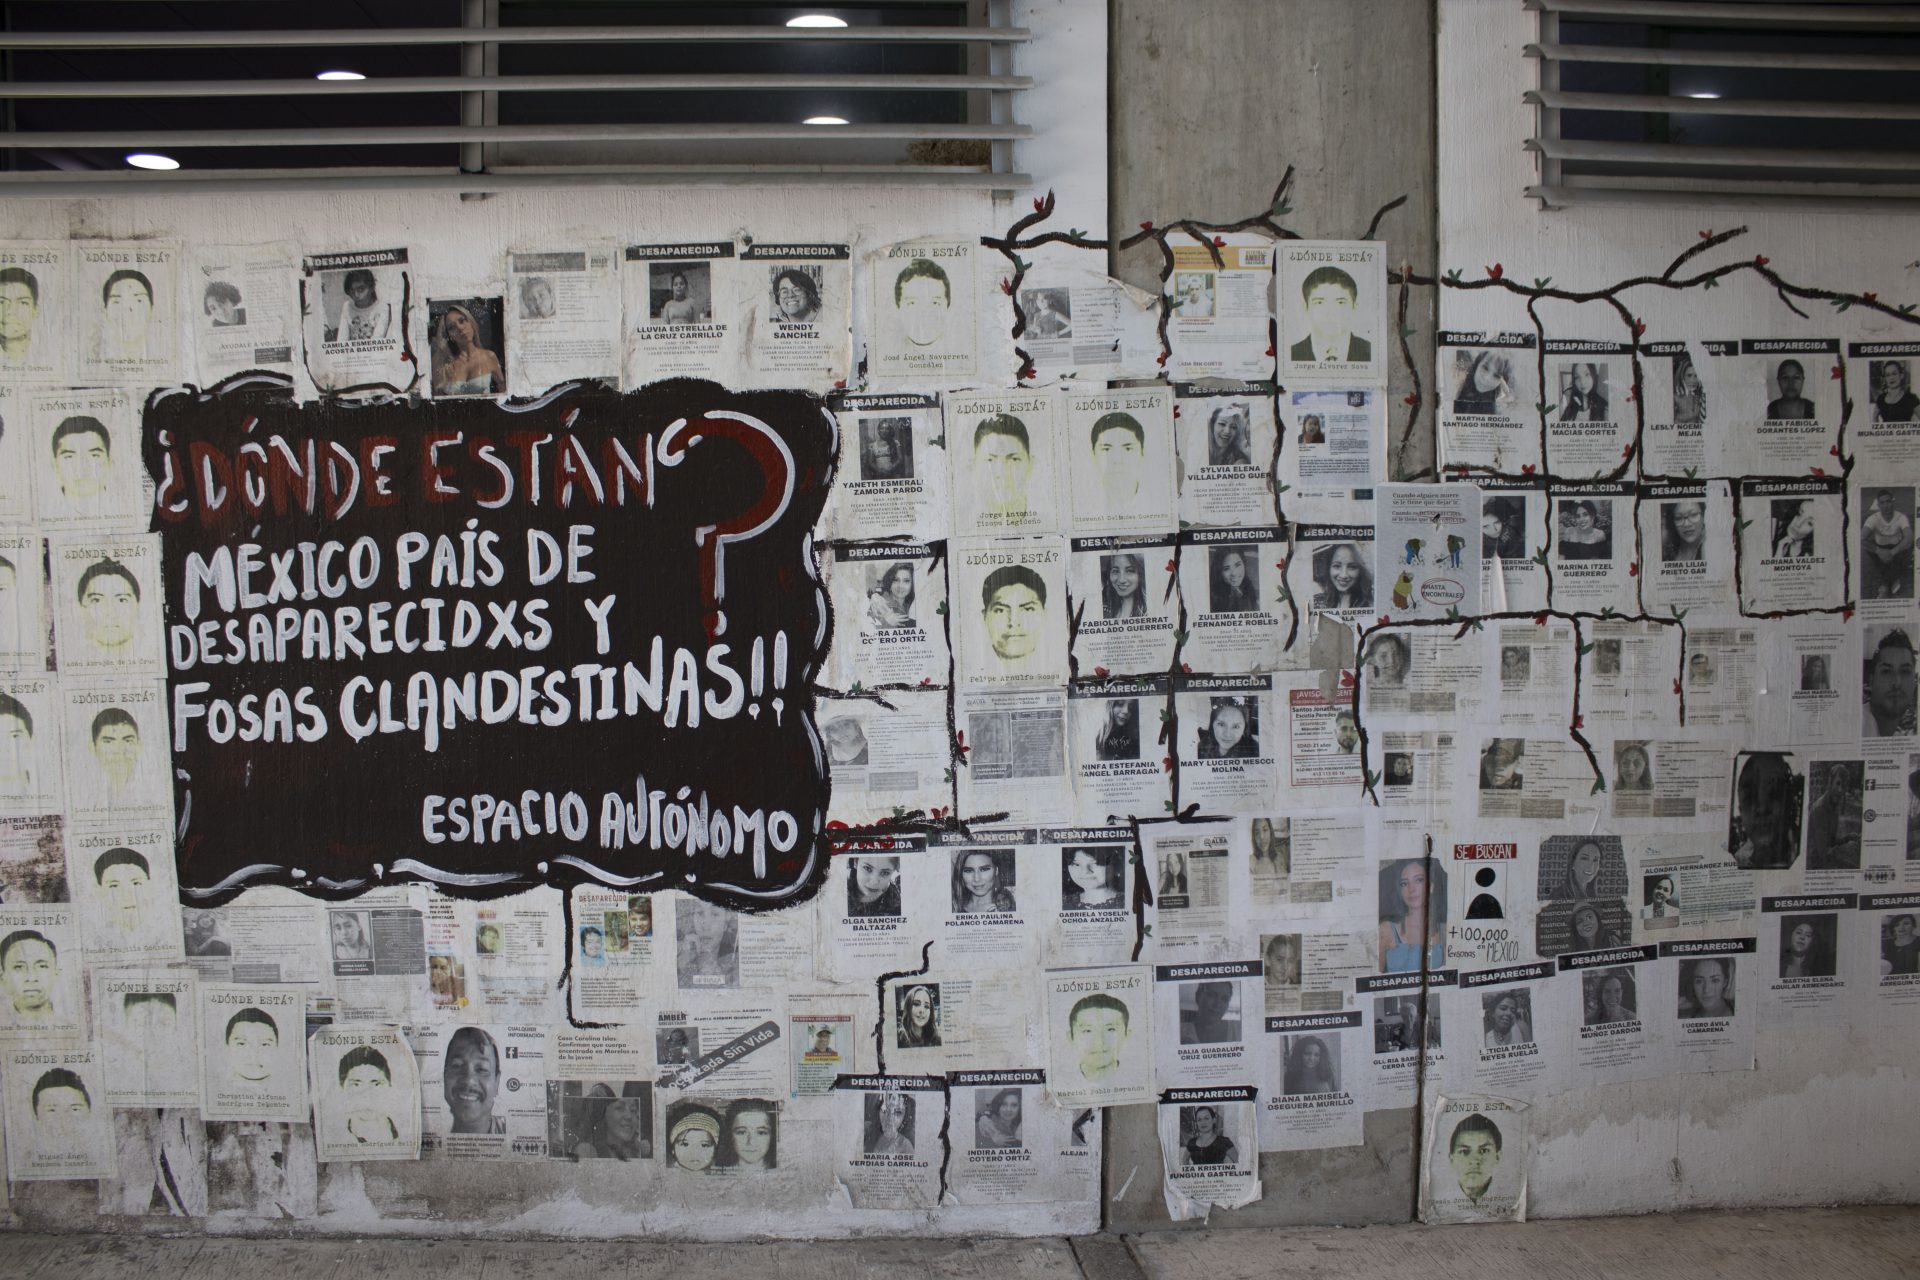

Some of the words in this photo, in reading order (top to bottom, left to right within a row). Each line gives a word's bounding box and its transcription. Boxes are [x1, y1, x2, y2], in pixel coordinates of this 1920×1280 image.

[639, 246, 721, 257] DESAPARECIDA
[754, 247, 836, 256] DESAPARECIDA
[932, 246, 968, 258] ESTÁ?
[1290, 250, 1332, 262] ¿DÓNDE
[1339, 251, 1373, 262] ESTÁ?
[135, 251, 171, 264] ESTÁ?
[315, 252, 394, 267] DESAPARECIDA
[680, 331, 723, 339] CARRILLO
[774, 331, 820, 340] SANCHEZ
[1545, 342, 1621, 351] DESAPARECIDA
[1753, 342, 1828, 351] DESAPARECIDA
[843, 396, 926, 408] DESAPARECIDA
[956, 403, 1002, 415] ¿DÓNDE
[1009, 400, 1046, 412] ESTÁ?
[1075, 400, 1119, 411] ¿DÓNDE
[1126, 397, 1161, 409] ESTÁ?
[843, 480, 878, 489] YANETH
[1755, 483, 1828, 492] DESAPARECIDA
[854, 488, 890, 496] ZAMORA
[893, 486, 923, 494] PARDO
[1193, 531, 1273, 541] DESAPARECIDA
[64, 547, 108, 559] ¿DÓNDE
[113, 546, 147, 557] ESTÁ?
[966, 553, 1013, 565] ¿DÓNDE
[1021, 551, 1059, 563] ESTÁ?
[184, 525, 380, 624] MÉXICO
[396, 517, 504, 590] PAÍS
[527, 525, 596, 585] DE
[1121, 617, 1169, 625] MOSERRAT
[1192, 620, 1243, 628] FERNANDEZ
[1245, 618, 1279, 626] ROBLES
[171, 598, 553, 670] DESAPARECIDXS
[584, 594, 616, 655] Y
[892, 629, 916, 637] ALMA
[1078, 626, 1125, 634] REGALADO
[1128, 623, 1174, 632] GUERRERO
[899, 635, 926, 643] ORTIZ
[1188, 678, 1267, 688] DESAPARECIDA
[174, 681, 328, 752] FOSAS
[339, 630, 788, 752] CLANDESTINAS!!
[72, 692, 117, 704] ¿DÓNDE
[121, 690, 155, 703] ESTÁ?
[1082, 763, 1107, 771] NINFA
[1108, 761, 1154, 769] ESTEFANIA
[1180, 760, 1204, 768] MARY
[1207, 759, 1240, 767] LUCERO
[1212, 765, 1245, 773] MOLINA
[1113, 767, 1159, 776] BARRAGAN
[422, 789, 589, 843] ESPACIO
[600, 773, 798, 880] AUTÓNOMO
[1053, 829, 1134, 840] DESAPARECIDA
[79, 836, 122, 848] ¿DÓNDE
[128, 833, 162, 845] ESTÁ?
[1456, 845, 1470, 858] SE
[1475, 845, 1511, 858] BUSCAN
[1645, 866, 1678, 874] ALONDRA
[1774, 897, 1846, 908] DESAPARECIDA
[34, 913, 68, 926] ESTÁ?
[867, 916, 908, 924] SANCHEZ
[852, 923, 896, 931] BALTAZAR
[1672, 942, 1744, 953] DESAPARECIDA
[1571, 950, 1645, 965] DESAPARECIDA
[1170, 965, 1249, 976] DESAPARECIDA
[1468, 967, 1542, 983] DESAPARECIDA
[106, 982, 149, 993] ¿DÓNDE
[155, 981, 190, 993] ESTÁ?
[1056, 980, 1100, 993] ¿DÓNDE
[1106, 977, 1141, 990] ESTÁ?
[211, 993, 253, 1005] ¿DÓNDE
[259, 993, 293, 1005] ESTÁ?
[1271, 1016, 1349, 1028] DESAPARECIDA
[1596, 1020, 1642, 1031] MAGDALENA
[322, 1034, 365, 1046] ¿DÓNDE
[723, 1044, 746, 1060] Sin
[744, 1029, 775, 1047] Vida
[1200, 1046, 1245, 1054] GUADALUPE
[1511, 1042, 1537, 1051] PAOLA
[14, 1052, 58, 1064] ¿DÓNDE
[1508, 1049, 1539, 1057] RUELAS
[851, 1077, 931, 1087] DESAPARECIDA
[960, 1073, 1040, 1083] DESAPARECIDA
[1171, 1088, 1249, 1099] DESAPARECIDA
[1271, 1095, 1301, 1103] DIANA
[1302, 1093, 1350, 1101] MARISELA
[1267, 1102, 1313, 1111] OSEGUERA
[1315, 1099, 1354, 1108] MURILLO
[888, 1160, 929, 1168] CARRILLO
[1207, 1170, 1252, 1178] GASTELUM
